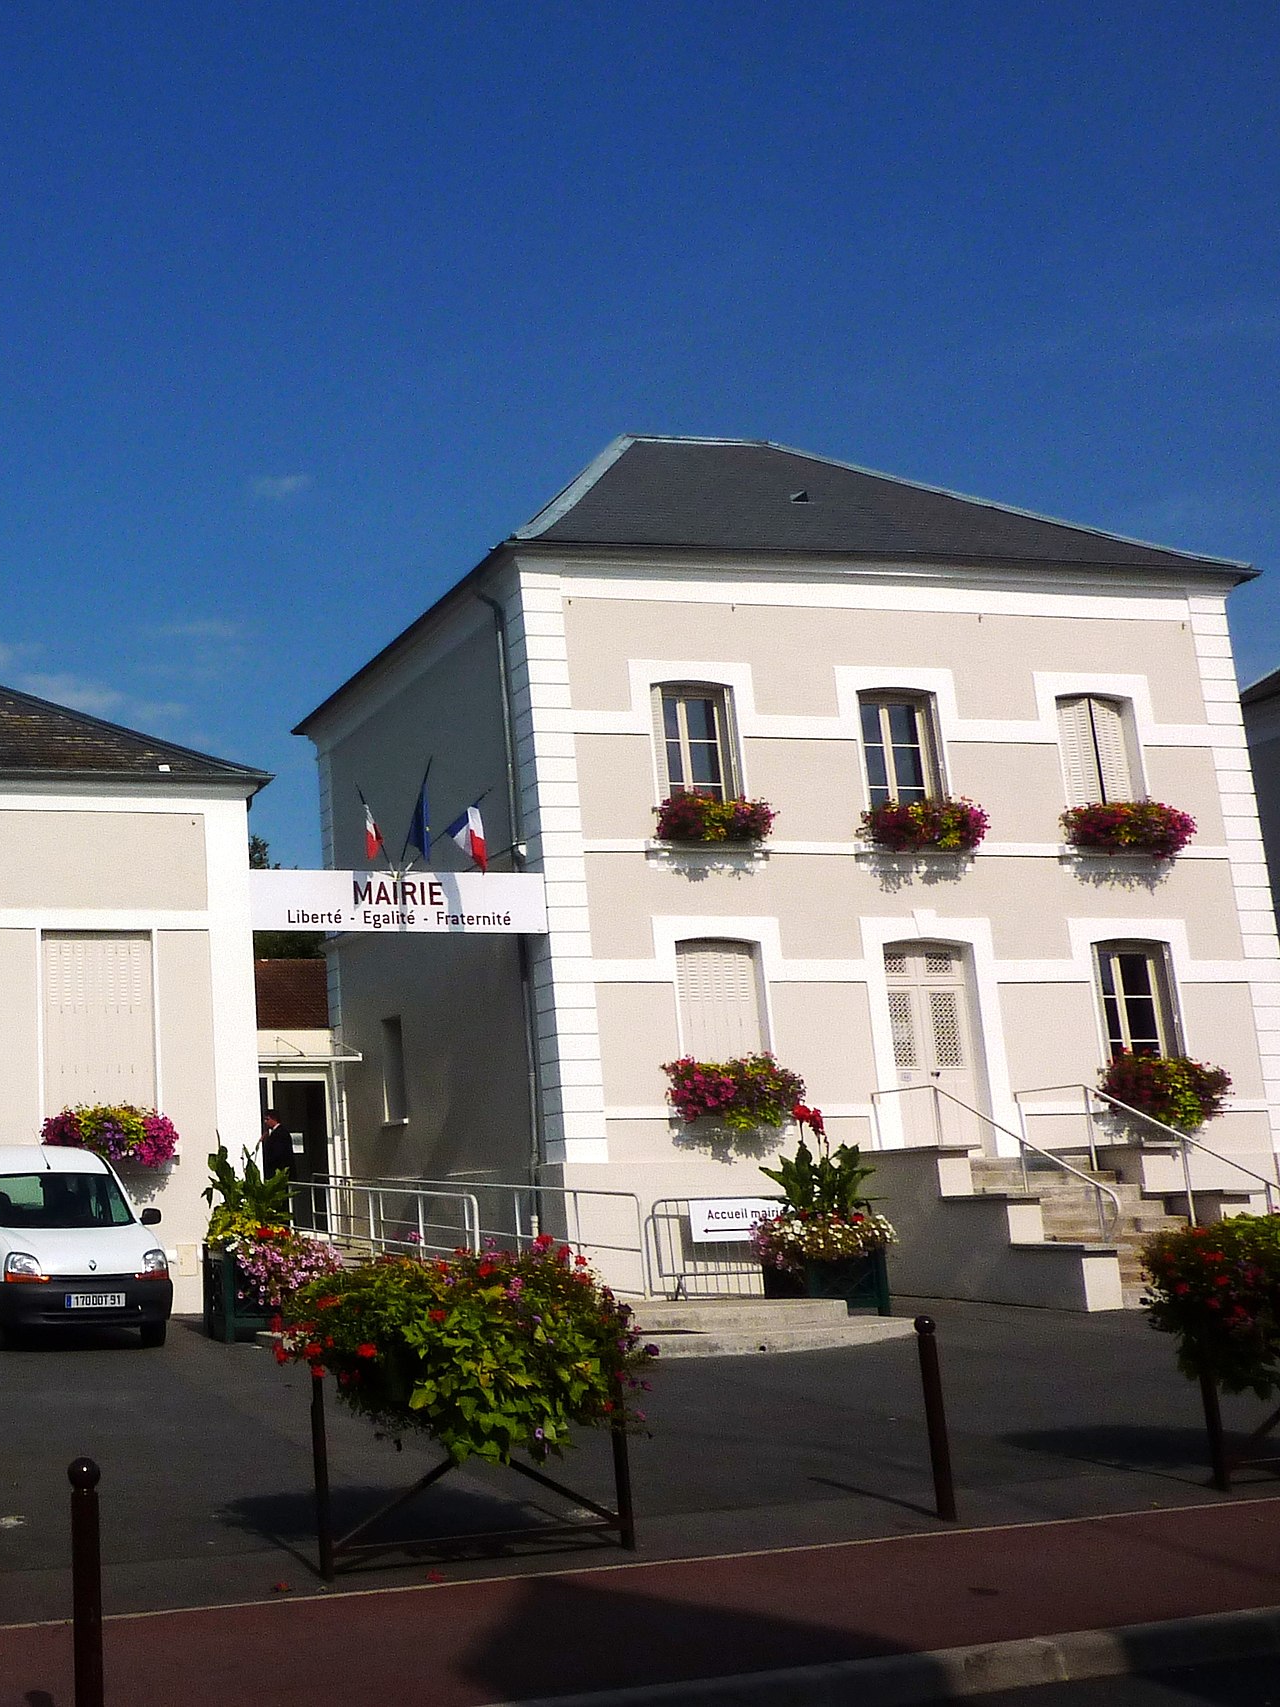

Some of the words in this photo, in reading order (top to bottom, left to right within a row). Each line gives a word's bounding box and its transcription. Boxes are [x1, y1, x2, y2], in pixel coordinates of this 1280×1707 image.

[352, 881, 445, 906] MAIRIE
[287, 909, 343, 924] Liberté
[363, 910, 416, 929] Egalité
[436, 911, 512, 927] Fraternité
[707, 1208, 748, 1220] Accueil
